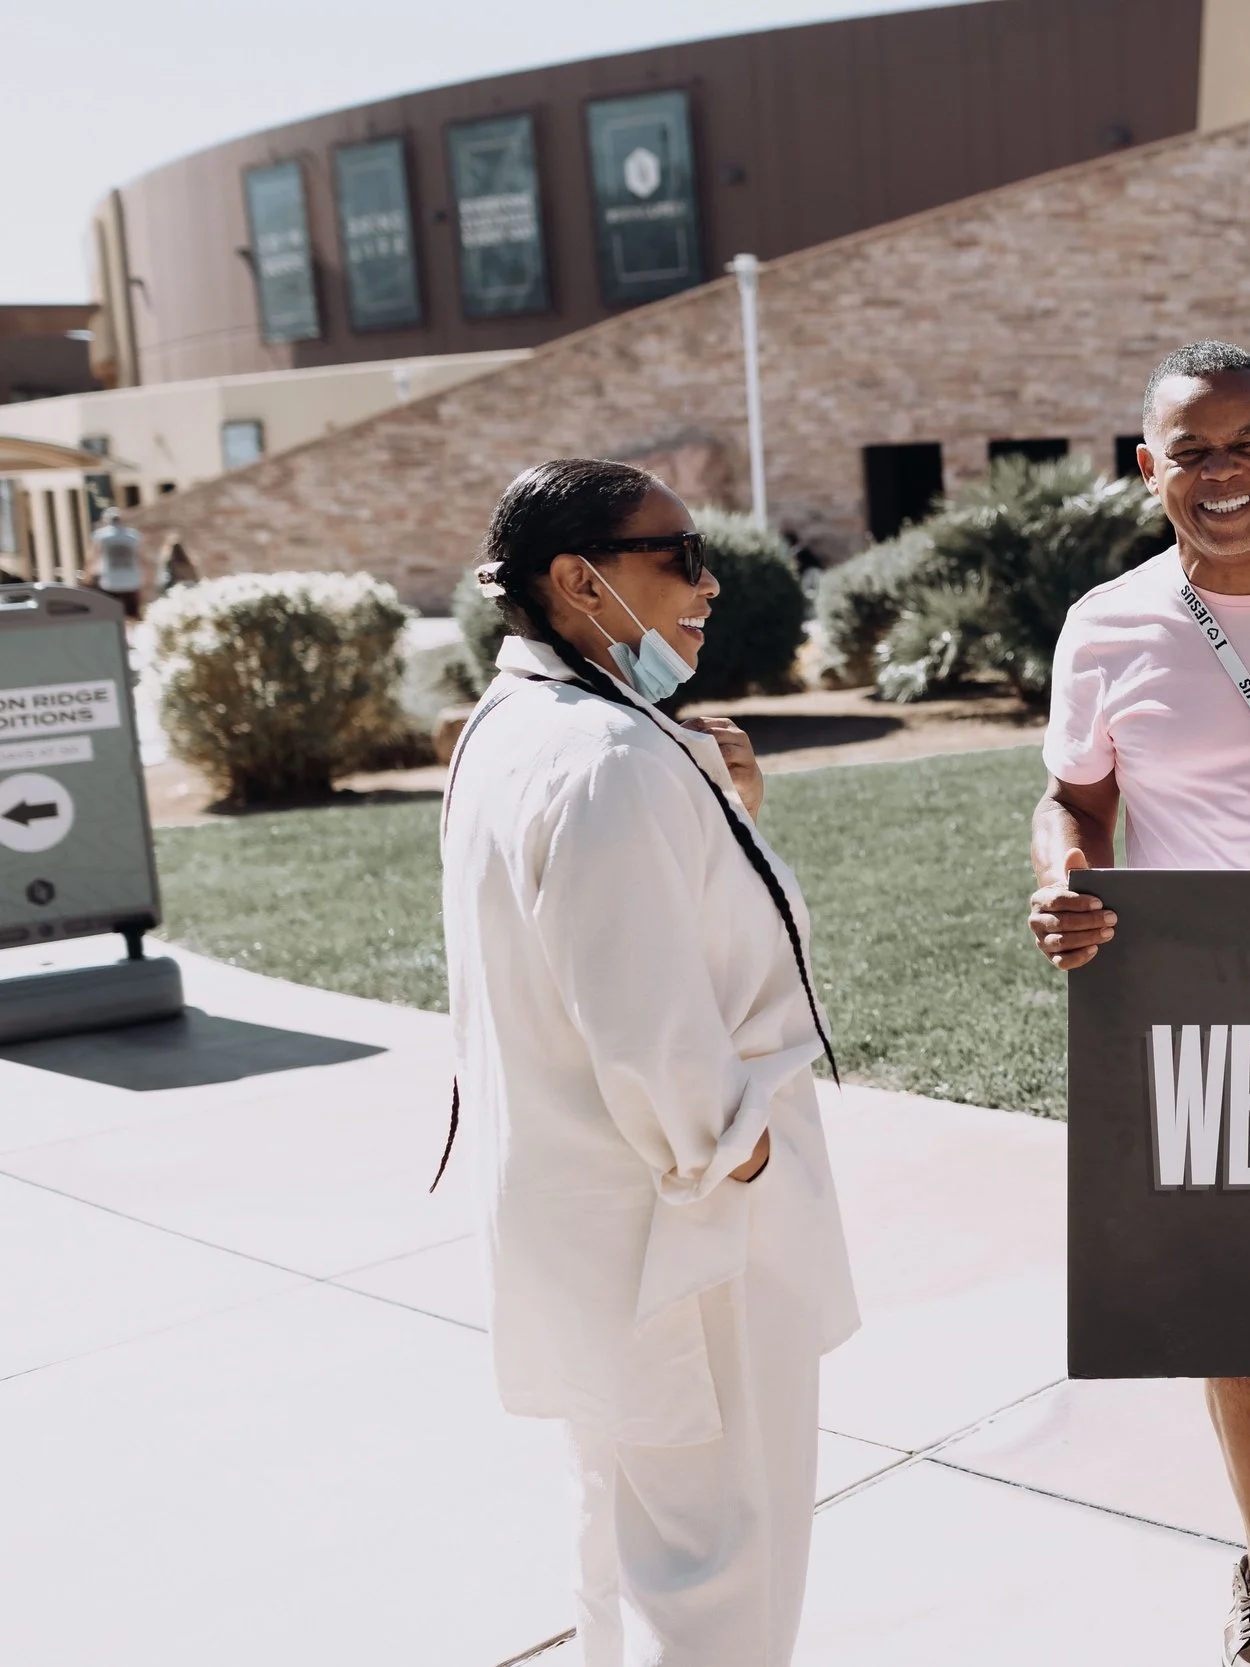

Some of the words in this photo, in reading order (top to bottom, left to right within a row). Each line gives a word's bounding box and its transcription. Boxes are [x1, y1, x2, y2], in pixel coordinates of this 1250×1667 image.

[1181, 584, 1213, 626] JESUS
[1215, 639, 1227, 651] I
[32, 687, 109, 709] RIDGE
